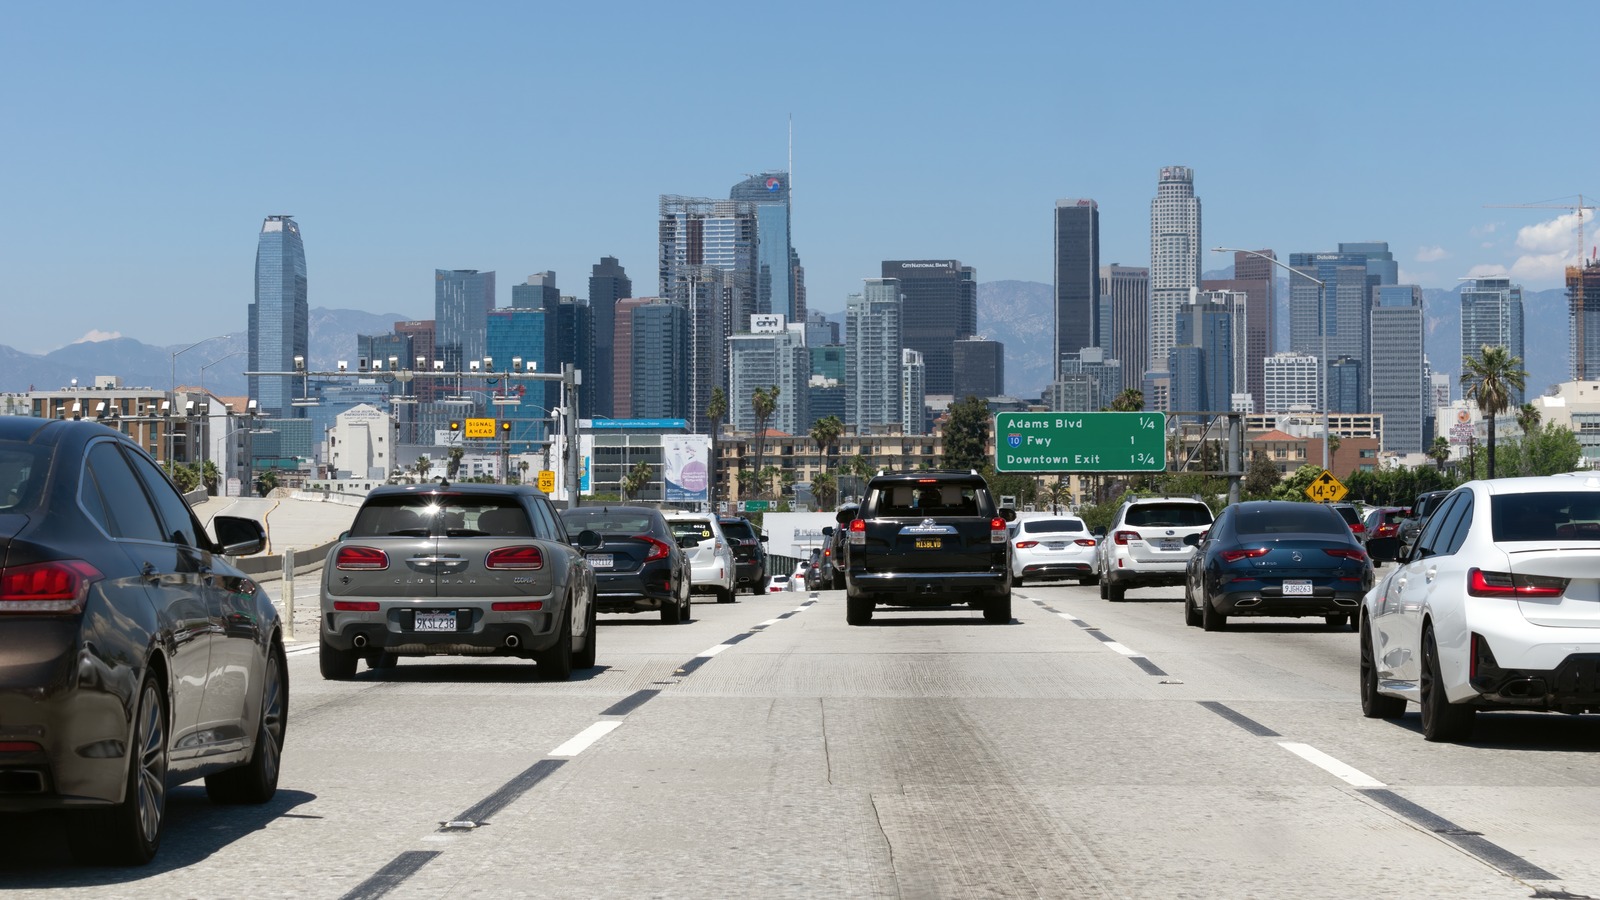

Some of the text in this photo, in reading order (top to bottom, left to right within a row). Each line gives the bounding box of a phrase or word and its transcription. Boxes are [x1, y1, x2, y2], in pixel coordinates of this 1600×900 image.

[1008, 418, 1049, 429] Adams
[1056, 418, 1082, 428] Blvd
[1027, 436, 1052, 447] Fwy
[1130, 436, 1134, 444] 1
[1007, 455, 1068, 464] Downtown
[1074, 455, 1100, 464] Exit
[416, 618, 454, 628] 9KSL238
